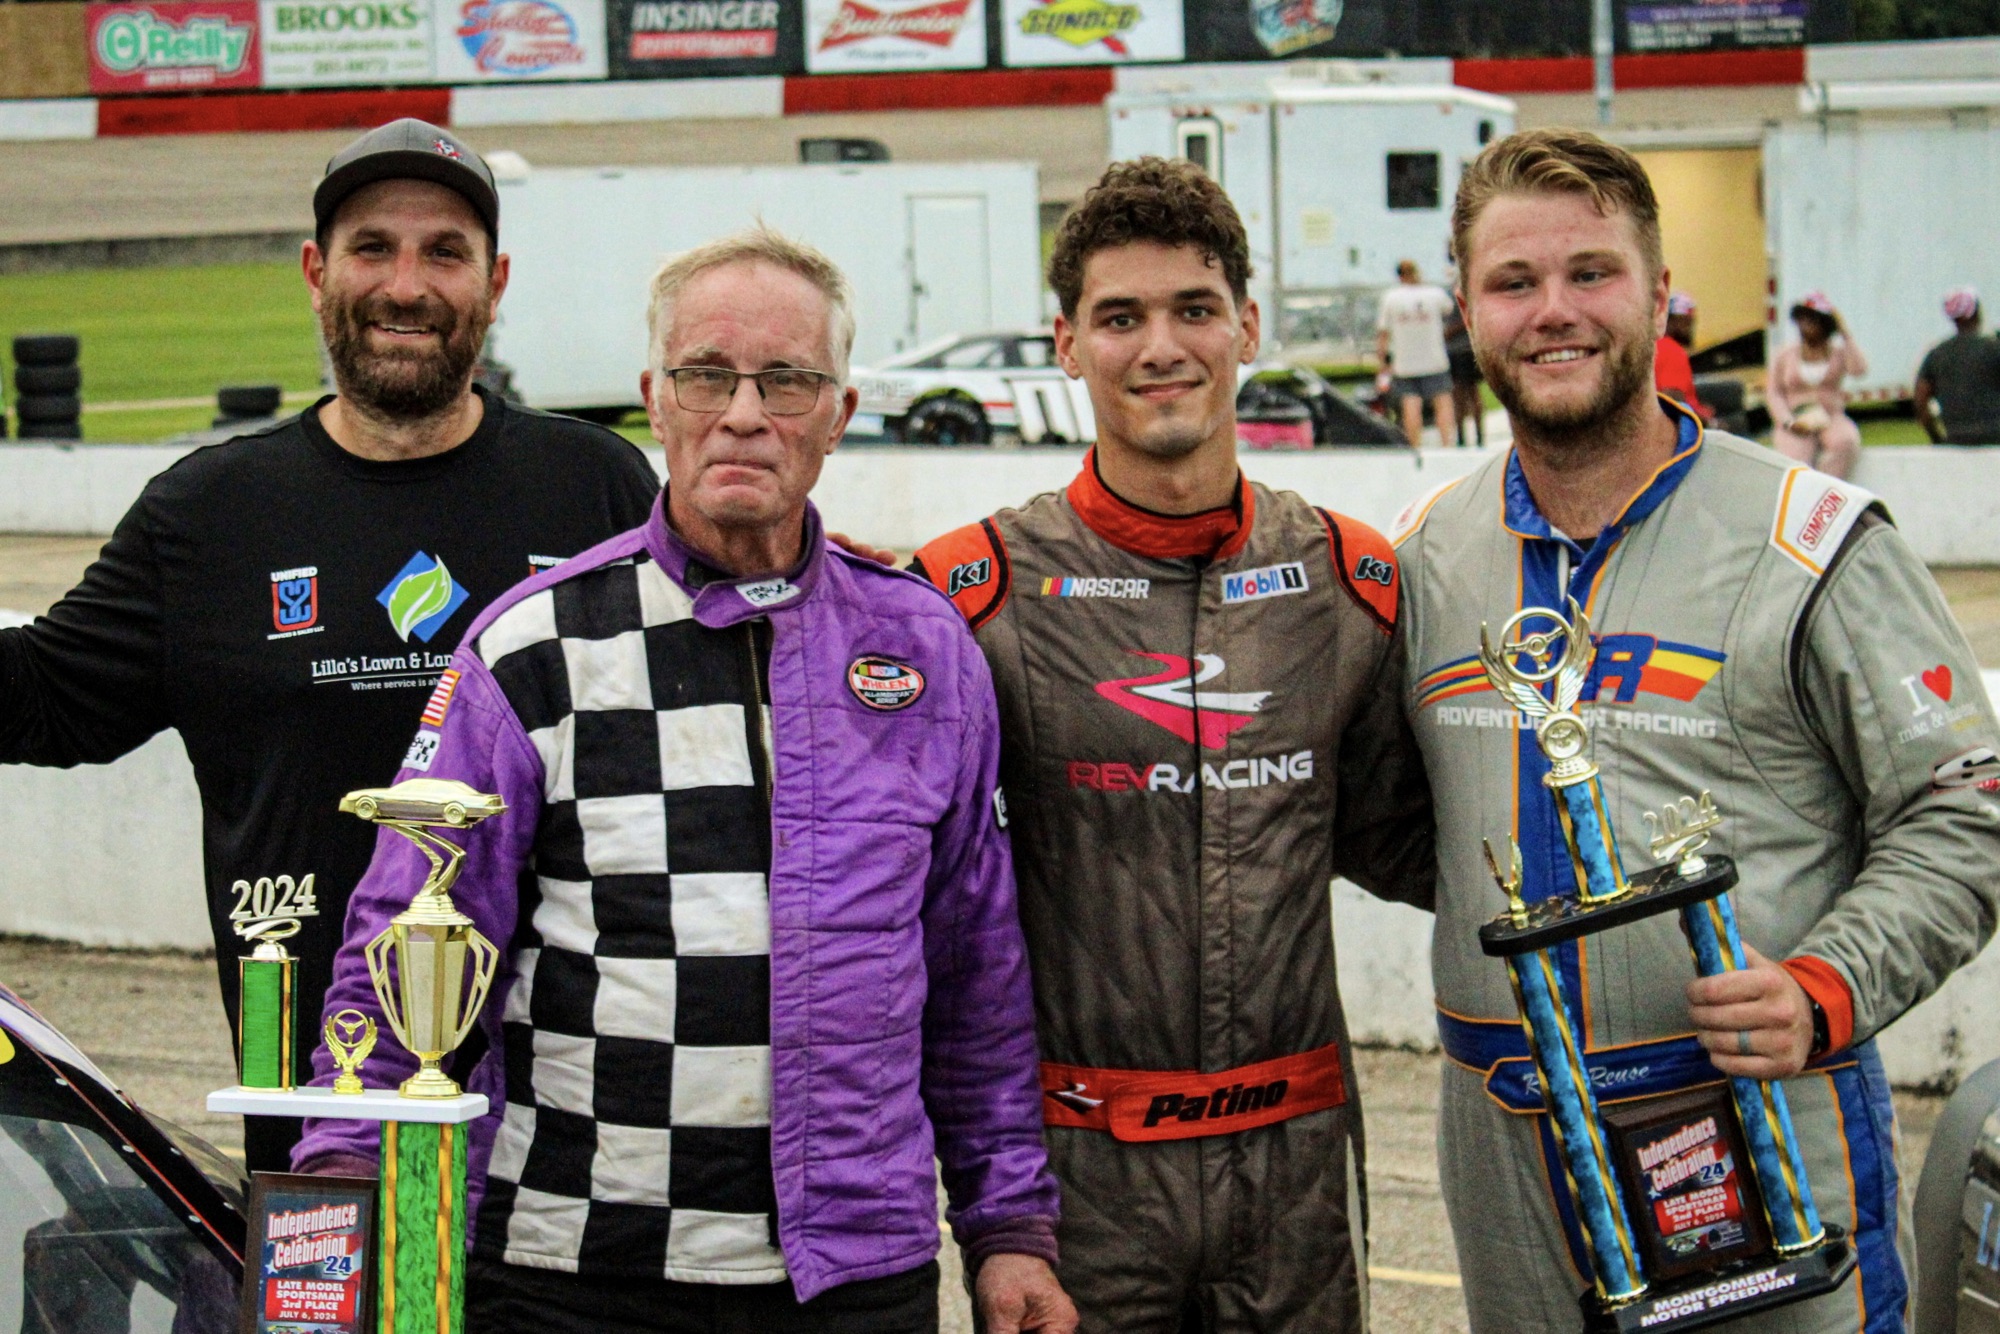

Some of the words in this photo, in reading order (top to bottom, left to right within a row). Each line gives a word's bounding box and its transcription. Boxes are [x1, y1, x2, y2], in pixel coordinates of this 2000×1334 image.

[275, 3, 418, 32] BROOKS
[631, 1, 779, 30] INSINGER
[105, 13, 248, 64] O'Reilly
[1802, 491, 1843, 545] SIMPSON
[270, 566, 318, 582] UNIFIED
[948, 557, 991, 597] K1
[1355, 555, 1394, 585] K1
[1069, 576, 1151, 600] NASCAR
[1226, 571, 1280, 599] Mobil
[311, 657, 359, 677] Lilla's
[361, 656, 407, 672] Lawn
[409, 652, 422, 668] &
[351, 682, 382, 691] Where
[384, 679, 417, 689] service
[418, 678, 426, 687] is
[859, 677, 911, 689] WHELEN
[1901, 675, 1931, 718] I
[1615, 710, 1717, 737] RACING
[1898, 721, 1930, 744] mac
[1931, 712, 1944, 729] &
[1643, 789, 1719, 846] 2024
[229, 873, 317, 919] 2024
[1143, 1079, 1288, 1127] Patino
[1637, 1116, 1717, 1170] Independence
[1651, 1146, 1717, 1192] Celebration
[1700, 1162, 1726, 1180] 24
[1663, 1196, 1686, 1208] LATE
[1689, 1185, 1725, 1200] MODEL
[1665, 1194, 1727, 1216] SPORTSMAN
[267, 1204, 358, 1240] Independence
[1673, 1212, 1692, 1222] 2nd
[1695, 1202, 1725, 1216] PLACE
[1674, 1221, 1691, 1231] JULY
[1705, 1212, 1725, 1222] 2024
[274, 1235, 347, 1270] Celebration
[323, 1254, 353, 1274] 24
[276, 1290, 344, 1301] SPORTSMAN
[277, 1281, 302, 1290] LATE
[305, 1282, 344, 1291] MODEL
[1640, 1301, 1705, 1327] MOTOR
[1709, 1274, 1797, 1308] SPEEDWAY
[1653, 1269, 1778, 1312] MONTGOMERY
[279, 1311, 299, 1319] JULY
[301, 1312, 311, 1320] 6,
[314, 1312, 337, 1320] 2024
[282, 1300, 301, 1309] 3rd
[305, 1301, 338, 1310] PLACE
